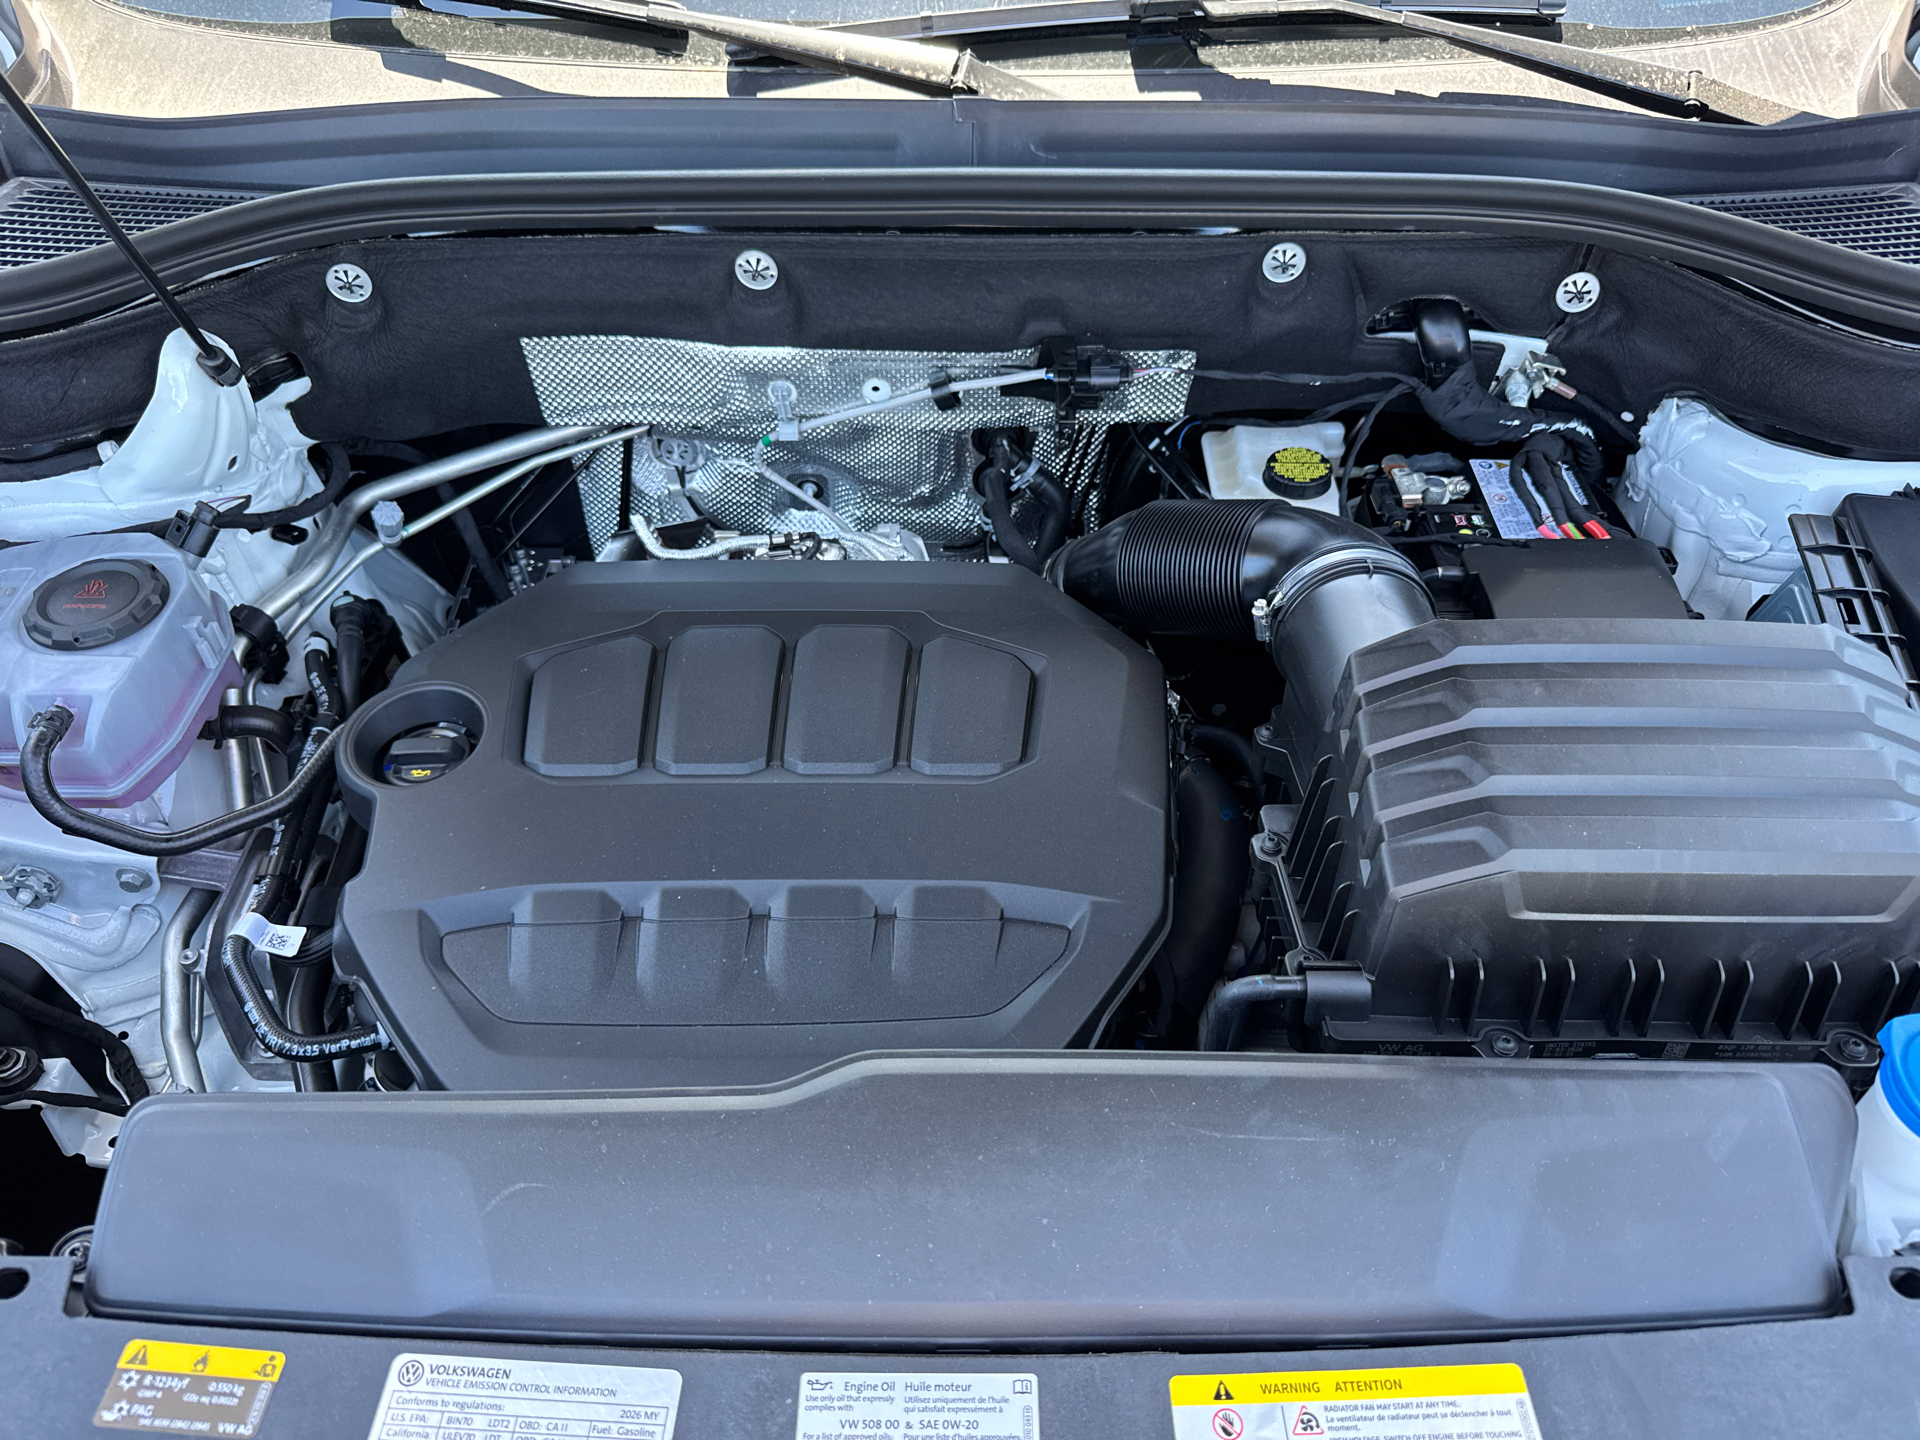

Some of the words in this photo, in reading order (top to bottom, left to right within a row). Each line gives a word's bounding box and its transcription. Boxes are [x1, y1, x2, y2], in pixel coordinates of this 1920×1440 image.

[255, 1023, 269, 1039] DE
[265, 1034, 283, 1050] VRT
[1378, 1043, 1401, 1052] VW
[1404, 1044, 1424, 1052] AG
[429, 1363, 512, 1380] VOLKSWAGEN
[425, 1377, 462, 1388] VEHICLE
[463, 1379, 508, 1391] EMISSION
[509, 1382, 551, 1394] CONTROL
[553, 1385, 618, 1398] INFORMATION
[844, 1381, 879, 1394] Engine
[881, 1381, 895, 1392] Oil
[905, 1381, 932, 1392] Huile
[934, 1382, 972, 1392] moteur
[1260, 1382, 1320, 1395] WARNING
[1335, 1379, 1403, 1393] ATTENTION
[396, 1395, 438, 1407] Conforms
[441, 1398, 450, 1407] to
[452, 1400, 505, 1411] regulations:
[805, 1394, 818, 1402] Use
[820, 1394, 835, 1404] only
[836, 1394, 845, 1402] oil
[846, 1394, 861, 1402] that
[862, 1394, 895, 1404] expressly
[904, 1396, 931, 1404] Utilisez
[932, 1396, 977, 1405] uniquement
[977, 1396, 987, 1404] de
[988, 1396, 1010, 1404] l'huile
[804, 1404, 836, 1413] complies
[837, 1404, 854, 1412] with
[904, 1405, 916, 1415] qui
[917, 1405, 946, 1413] satisfait
[947, 1405, 997, 1415] expressément
[998, 1405, 1003, 1413] à
[1324, 1404, 1360, 1413] RADIATOR
[1392, 1402, 1414, 1410] START
[1415, 1401, 1424, 1409] AT
[1440, 1400, 1460, 1408] TIME.
[391, 1413, 406, 1422] U.S.
[409, 1413, 430, 1423] EPA:
[620, 1409, 642, 1420] 2026
[644, 1411, 660, 1420] MY
[1326, 1415, 1334, 1423] Le
[1335, 1414, 1376, 1423] ventilateur
[1387, 1412, 1420, 1421] radiateur
[1421, 1412, 1439, 1420] peut
[1449, 1410, 1488, 1418] déclencher
[446, 1415, 474, 1426] BIN70
[488, 1418, 511, 1429] LDT2
[519, 1420, 542, 1431] OBD:
[546, 1421, 560, 1432] CA
[840, 1419, 860, 1430] VW
[861, 1419, 882, 1430] 508
[884, 1419, 900, 1430] 00
[905, 1420, 914, 1430] &
[919, 1419, 940, 1430] SAE
[942, 1419, 979, 1430] 0W-20
[217, 1421, 238, 1434] VW
[236, 1423, 254, 1436] AG
[386, 1427, 432, 1439] California:
[591, 1426, 613, 1435] Fuel:
[617, 1426, 656, 1438] Gasoline
[1327, 1424, 1361, 1432] moment.
[442, 1430, 476, 1440] ULEV70
[803, 1432, 815, 1440] For
[821, 1432, 833, 1440] list
[833, 1432, 841, 1440] of
[903, 1432, 923, 1440] Pour
[935, 1432, 950, 1440] liste
[1427, 1432, 1454, 1440] ENGINE
[1456, 1431, 1484, 1440] BEFORE
[1485, 1430, 1522, 1439] TOUCHING
